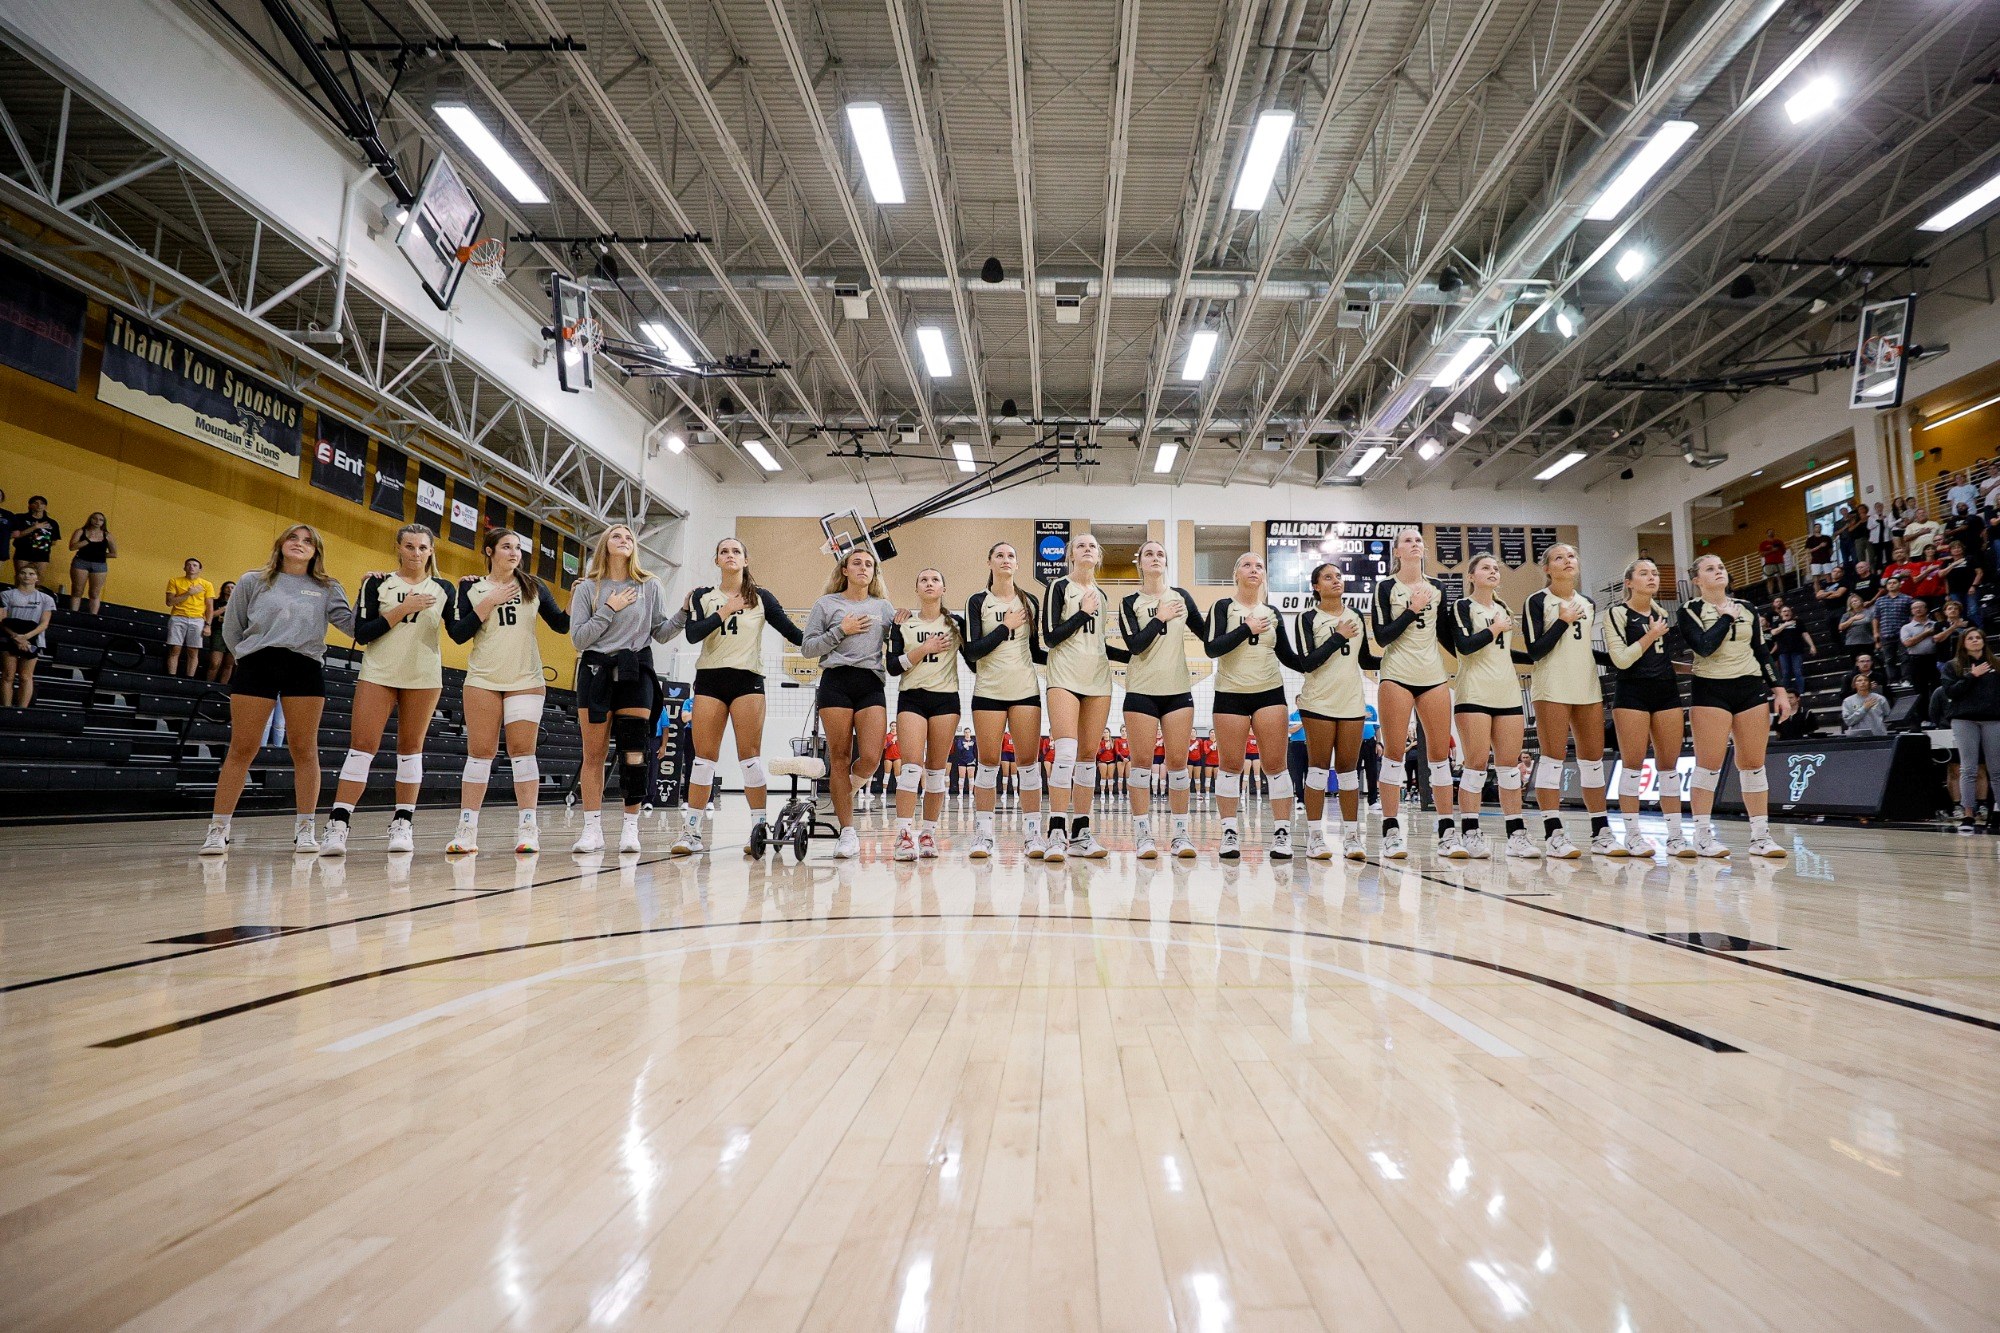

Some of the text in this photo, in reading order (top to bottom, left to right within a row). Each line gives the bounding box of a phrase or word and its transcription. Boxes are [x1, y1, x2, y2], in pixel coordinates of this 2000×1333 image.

[112, 313, 296, 428] Thank You Sponsors
[195, 416, 242, 445] Mountain
[256, 442, 280, 460] Lions
[334, 448, 365, 477] Ent
[1270, 523, 1329, 536] GALLOGLY
[1331, 524, 1375, 537] EVENTS
[1042, 547, 1065, 555] NCAA
[1377, 561, 1386, 574] 0
[1364, 582, 1371, 593] 2
[1283, 597, 1369, 609] GO MTAIN
[497, 606, 517, 626] 16
[1083, 616, 1095, 634] 10
[1416, 612, 1425, 629] 5
[721, 616, 738, 635] 14
[1572, 621, 1582, 640] 3
[1495, 631, 1505, 649] 4
[660, 704, 681, 775] UCCS
